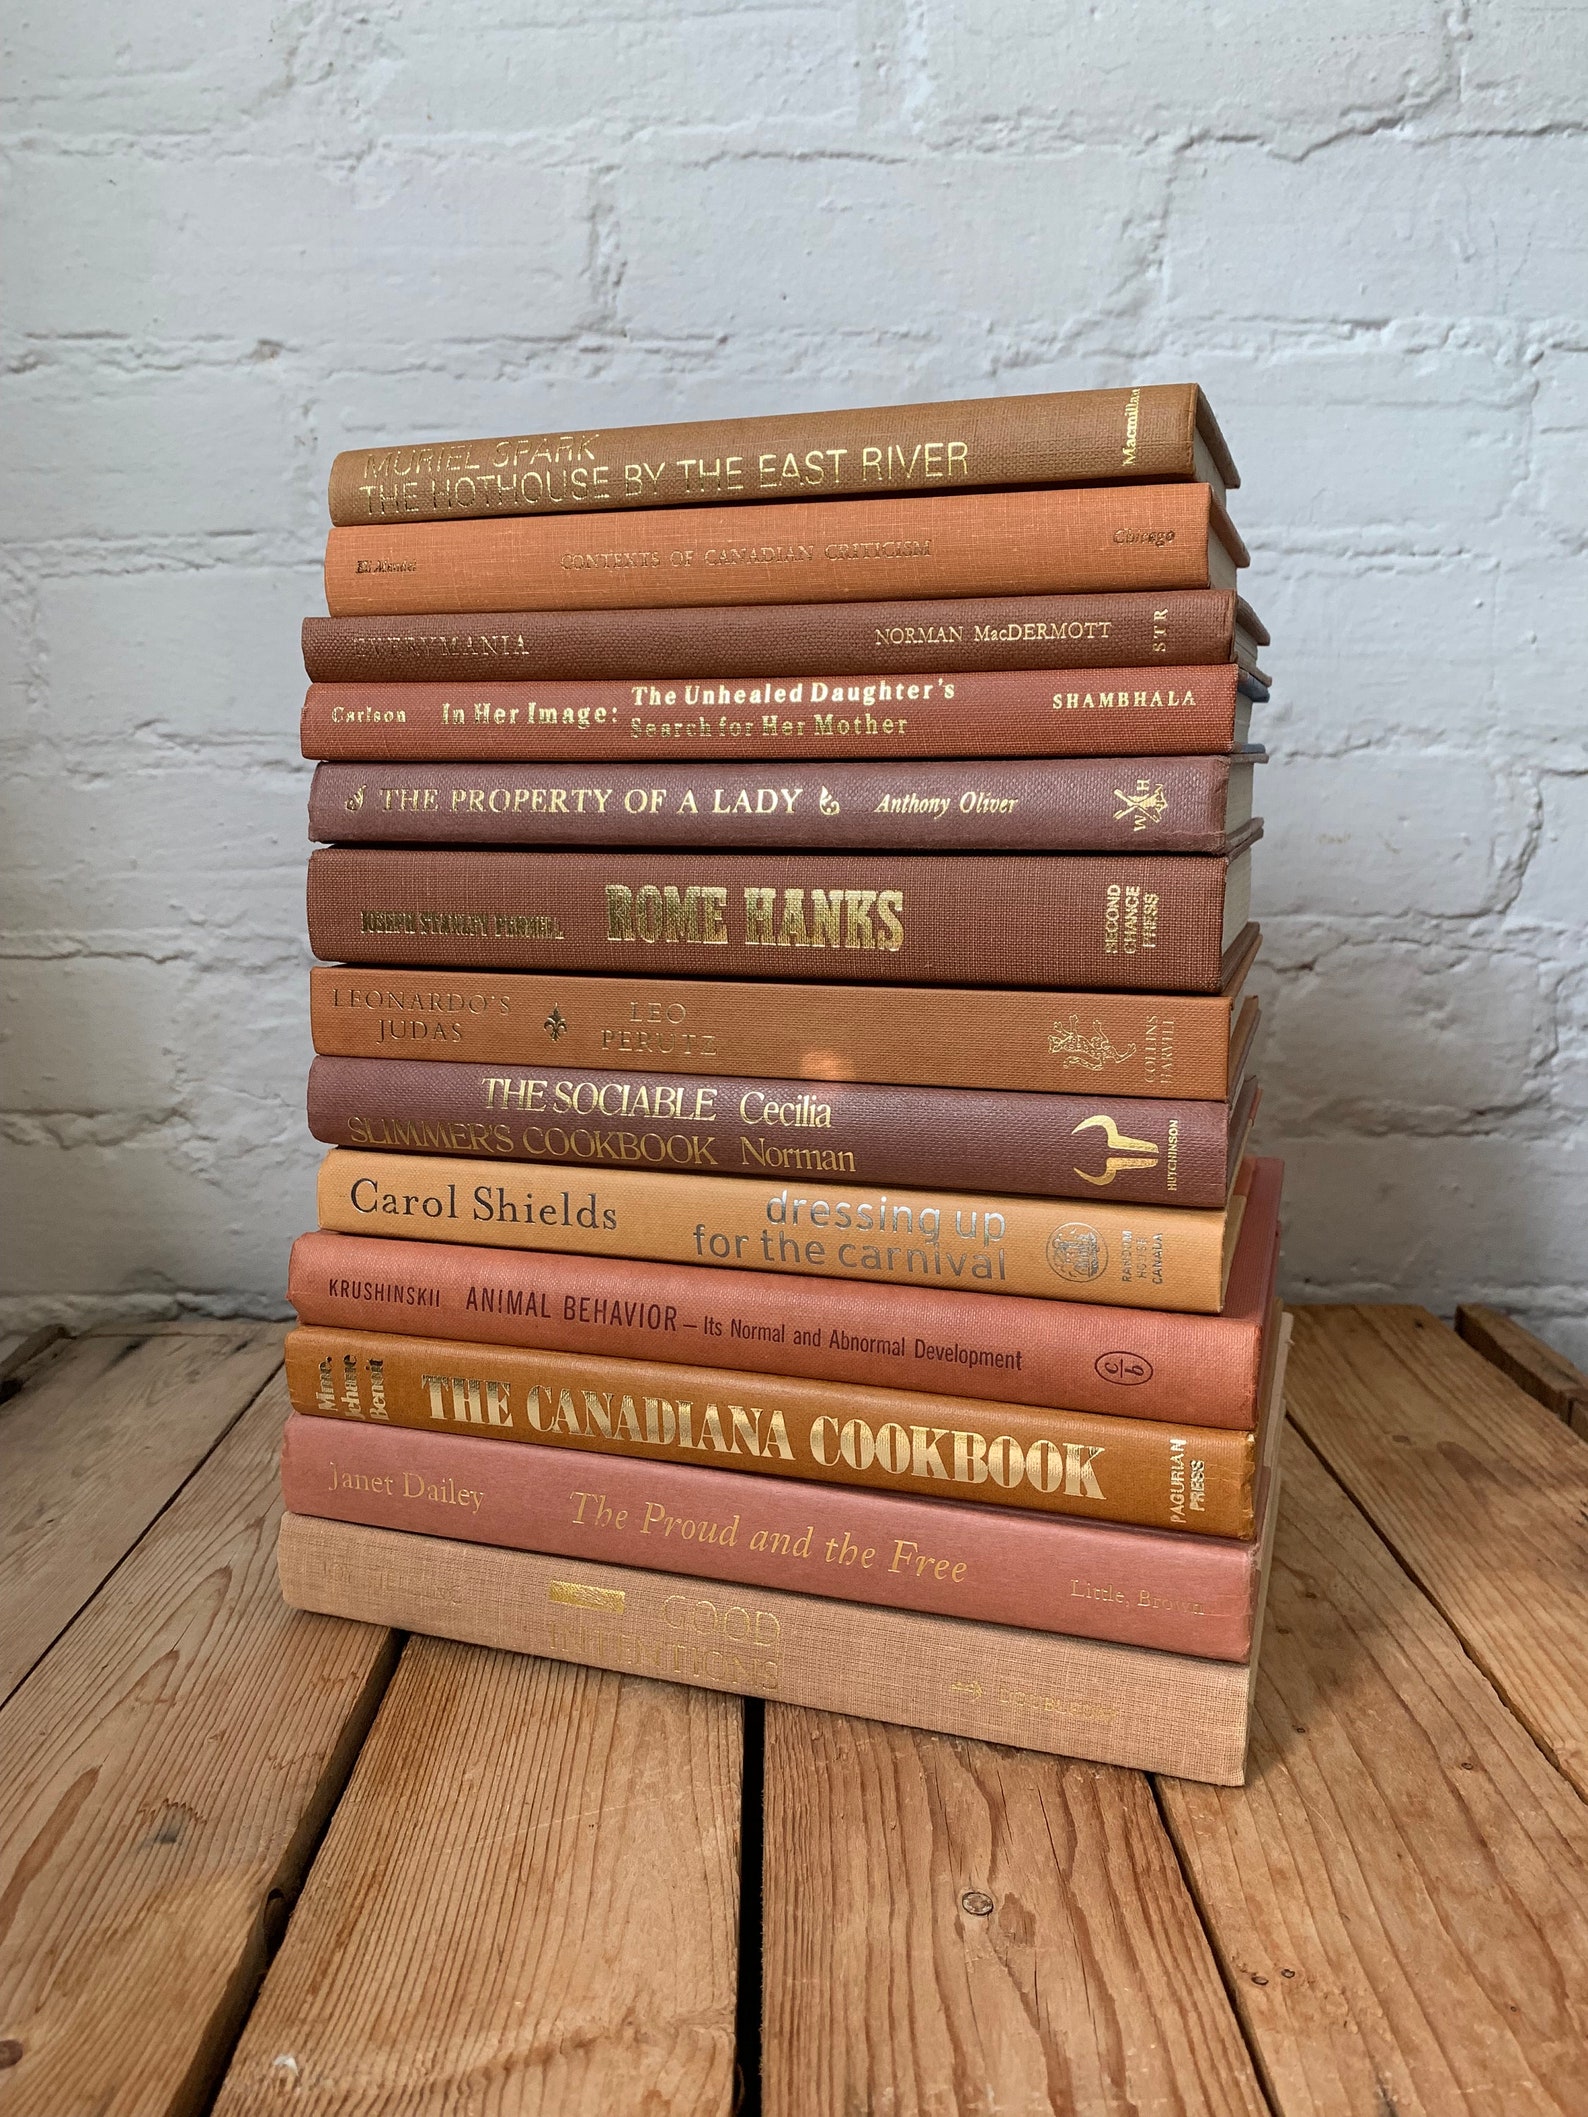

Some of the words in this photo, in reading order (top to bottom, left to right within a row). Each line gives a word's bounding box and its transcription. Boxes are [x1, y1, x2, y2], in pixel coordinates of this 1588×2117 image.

[1121, 388, 1140, 467] Macmillan
[359, 482, 418, 515] THE
[432, 466, 610, 510] HOTHOUSE
[624, 461, 665, 496] BY
[680, 456, 743, 493] THE
[759, 448, 847, 489] EAST
[862, 441, 968, 482] RIVER
[364, 444, 479, 478] MURIEL
[493, 433, 600, 468] SPARK
[560, 551, 660, 571] CONTEXTS
[670, 550, 694, 568] OF
[704, 545, 814, 566] CANADIAN
[824, 540, 931, 562] CRITICISM
[1113, 528, 1175, 547] Chicago
[875, 626, 963, 646] NORMAN
[974, 622, 1112, 642] MacDERMOTT
[331, 706, 407, 725] Carlson
[441, 702, 465, 725] In
[474, 702, 519, 725] Her
[528, 701, 618, 729] Image:
[631, 686, 677, 706] The
[684, 682, 803, 706] Unhealed
[811, 678, 956, 706] Daughter's
[1052, 689, 1197, 710] SHAMBHALA
[630, 717, 712, 738] Search
[718, 716, 754, 737] for
[761, 715, 806, 737] Her
[813, 713, 908, 736] Mother
[379, 788, 439, 813] THE
[451, 788, 614, 815] PROPERTY
[623, 788, 666, 815] OF
[676, 788, 699, 815] A
[711, 788, 803, 815] LADY
[873, 792, 951, 820] Anthony
[960, 790, 1019, 815] Oliver
[604, 884, 729, 945] ROME
[743, 886, 905, 952] HANKS
[1105, 884, 1121, 954] SECOND
[1123, 886, 1140, 954] CHANCE
[1142, 892, 1160, 948] PRESS
[333, 988, 511, 1017] LEONARDO'S
[630, 1001, 687, 1025] LEO
[376, 1019, 464, 1046] JUDAS
[601, 1028, 718, 1057] PERUTZ
[1144, 1015, 1158, 1083] COLLINS
[482, 1076, 548, 1114] THE
[552, 1080, 718, 1122] SOCIABLE
[739, 1090, 833, 1129] Cecilia
[347, 1116, 515, 1155] SLIMMER'S
[523, 1124, 718, 1166] COOKBOOK
[740, 1135, 857, 1174] Norman
[1167, 1119, 1180, 1191] HUTCHINSON
[350, 1177, 457, 1219] Carol
[472, 1185, 618, 1232] Shields
[766, 1189, 941, 1245] dressing
[955, 1208, 1007, 1247] up
[693, 1224, 749, 1259] for
[761, 1229, 826, 1265] the
[838, 1241, 1006, 1281] carnival
[1122, 1230, 1133, 1283] RANDOM
[1137, 1237, 1148, 1279] HOUSE
[1152, 1233, 1163, 1284] CANADA
[328, 1278, 440, 1309] KRUSHINSKII
[465, 1286, 551, 1320] ANIMAL
[563, 1295, 678, 1332] BEHAVIOR
[704, 1315, 723, 1337] Its
[730, 1318, 785, 1344] Normal
[793, 1327, 821, 1348] and
[829, 1329, 905, 1358] Abnormal
[914, 1338, 1023, 1371] Development
[364, 1358, 389, 1420] Benoit
[421, 1373, 514, 1428] THE
[526, 1384, 796, 1461] CANADIANA
[810, 1415, 1107, 1500] COOKBOOK
[328, 1462, 394, 1497] Janet
[402, 1471, 486, 1514] Dailey
[1169, 1438, 1187, 1523] PAGURIAN
[1189, 1459, 1206, 1512] PRESS
[569, 1490, 628, 1531] The
[640, 1501, 741, 1547] Proud
[749, 1526, 814, 1559] and
[825, 1531, 877, 1570] the
[888, 1539, 968, 1583] Free
[663, 1594, 781, 1647] GOOD
[1070, 1579, 1129, 1608] Little,
[1137, 1589, 1205, 1616] Brown
[550, 1620, 779, 1691] INTENTIONS
